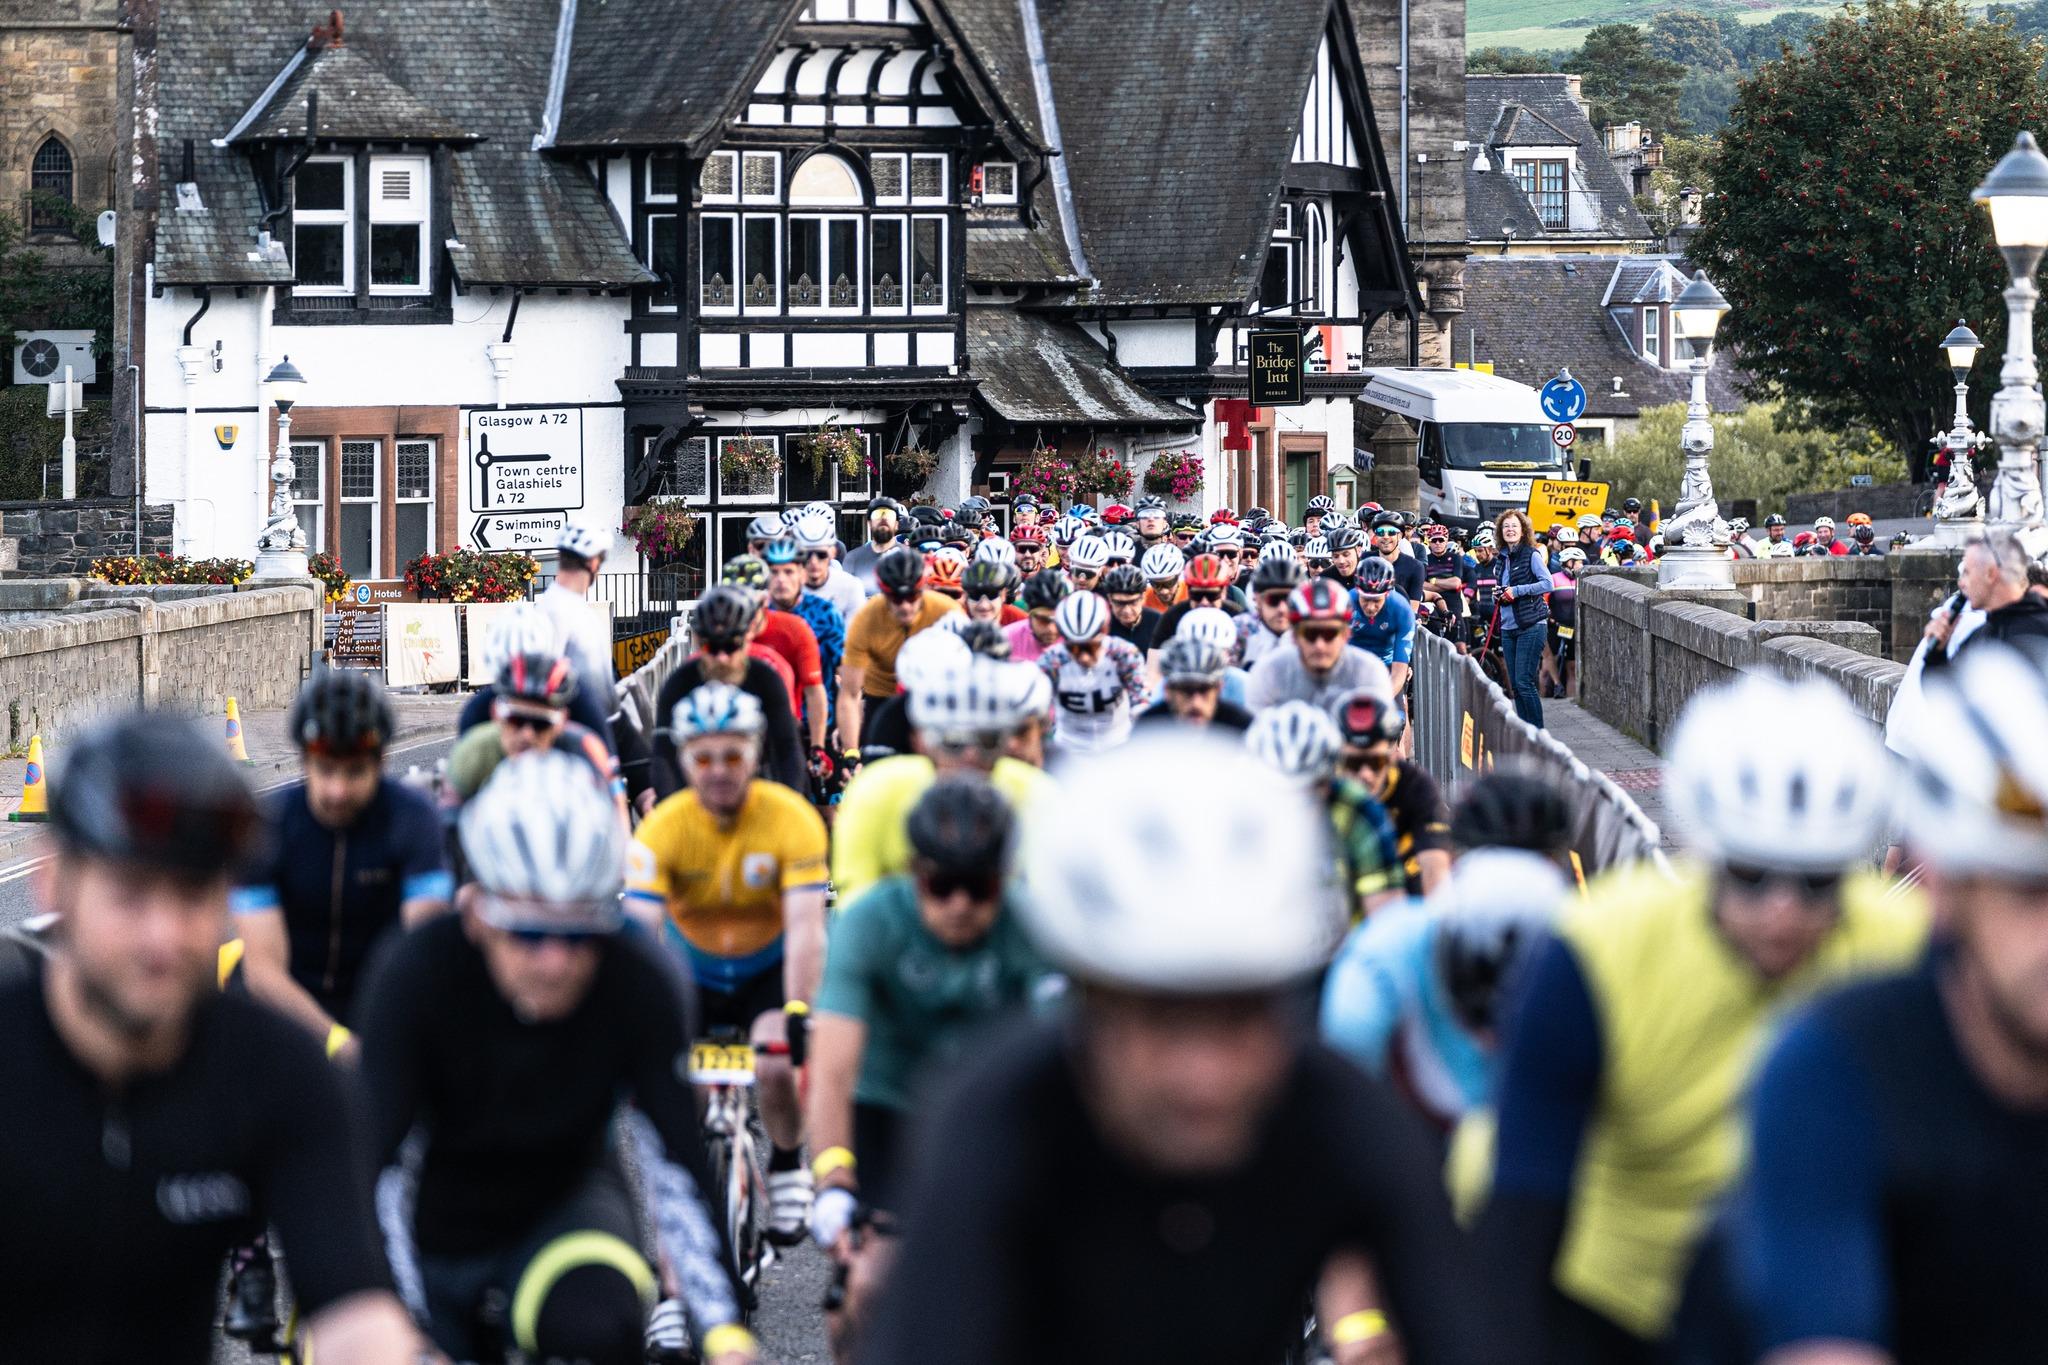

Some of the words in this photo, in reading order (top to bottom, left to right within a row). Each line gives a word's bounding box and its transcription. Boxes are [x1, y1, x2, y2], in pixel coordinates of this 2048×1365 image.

[1267, 341, 1284, 353] The
[1256, 355, 1296, 371] Bridge
[1267, 370, 1289, 384] Inn
[478, 416, 533, 427] Glasgow
[539, 414, 548, 425] A
[552, 413, 568, 424] 72
[1556, 431, 1573, 441] 20
[496, 466, 530, 477] Town
[536, 465, 577, 476] centre
[496, 478, 562, 490] Galashiels
[1542, 483, 1599, 496] Diverted
[497, 494, 505, 504] A
[510, 493, 525, 504] 72
[1547, 494, 1590, 507] Traffic
[496, 518, 561, 530] Swimming
[374, 589, 402, 598] Hotels
